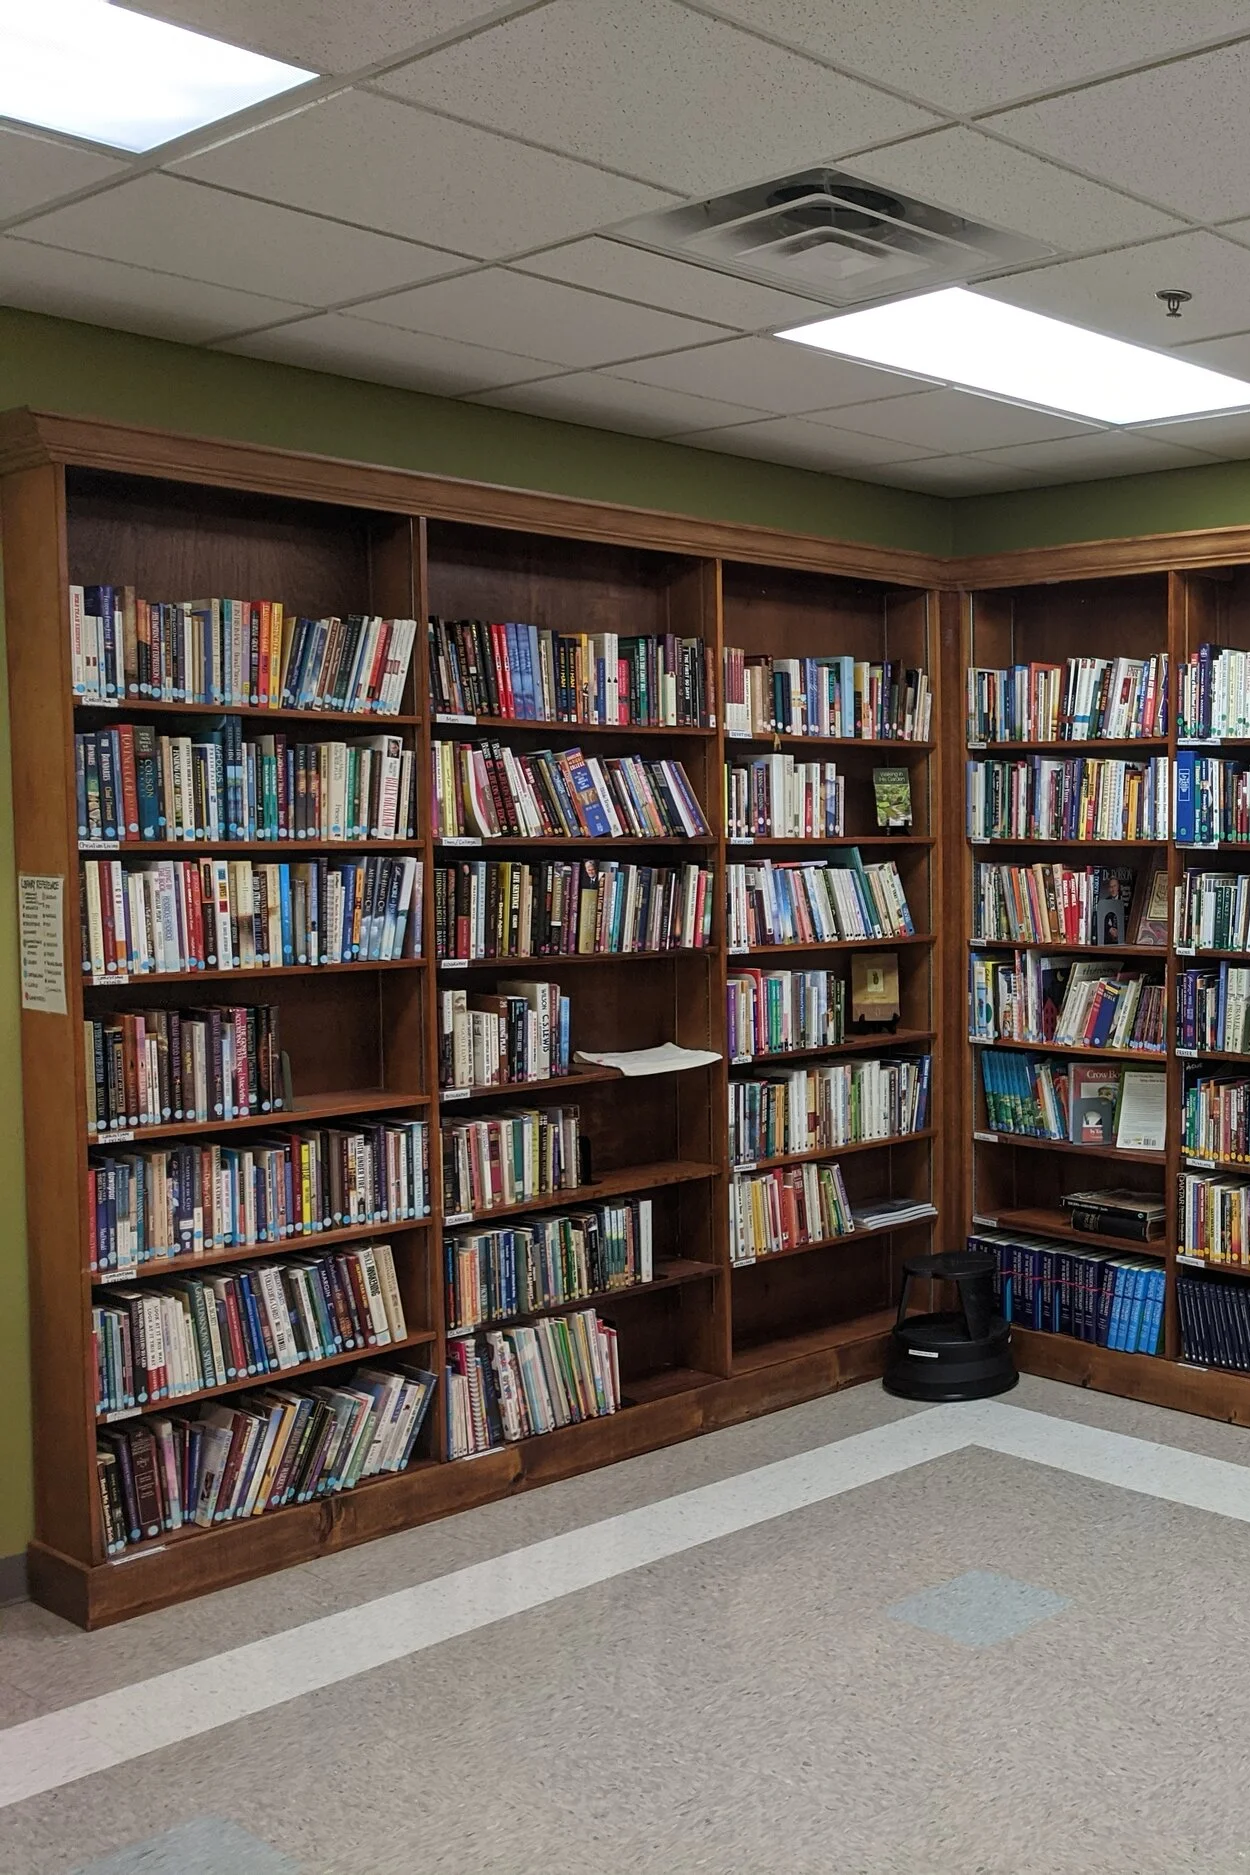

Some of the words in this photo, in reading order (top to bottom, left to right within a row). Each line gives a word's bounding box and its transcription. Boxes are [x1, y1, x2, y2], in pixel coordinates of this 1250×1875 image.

[144, 760, 154, 798] COLSON
[385, 777, 398, 795] BILLY
[383, 797, 395, 827] GRAHAM
[1086, 1070, 1107, 1079] Crow
[320, 1270, 331, 1297] MARGIN
